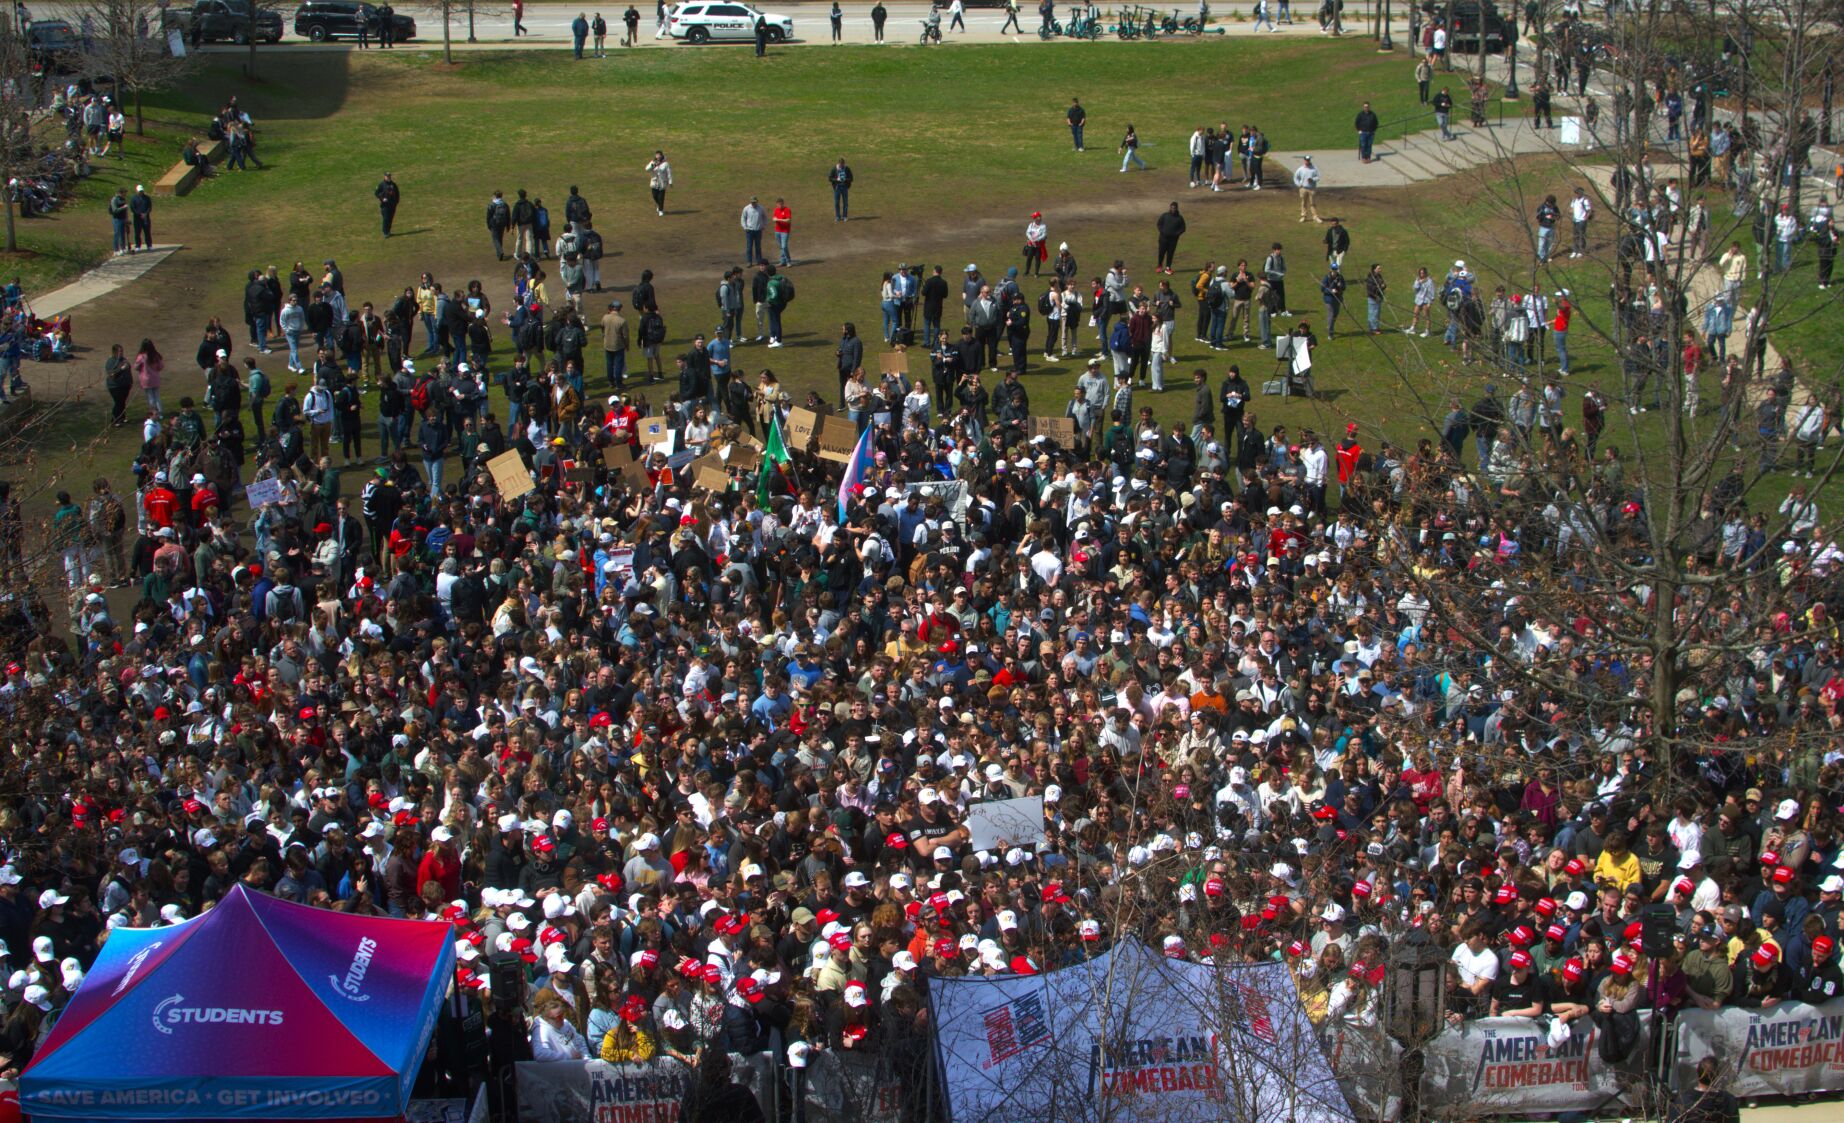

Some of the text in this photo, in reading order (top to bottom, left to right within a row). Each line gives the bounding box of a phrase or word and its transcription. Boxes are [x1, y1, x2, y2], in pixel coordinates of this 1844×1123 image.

[794, 424, 811, 435] LOVE
[344, 936, 377, 993] STUDENTS
[167, 1008, 284, 1025] STUDENTS
[1750, 1015, 1762, 1024] THE
[1484, 1029, 1497, 1038] THE
[591, 1071, 604, 1080] THE
[1484, 1059, 1590, 1089] COMEBACK
[38, 1088, 380, 1106] SAVE AMERICA GET INVOLVED
